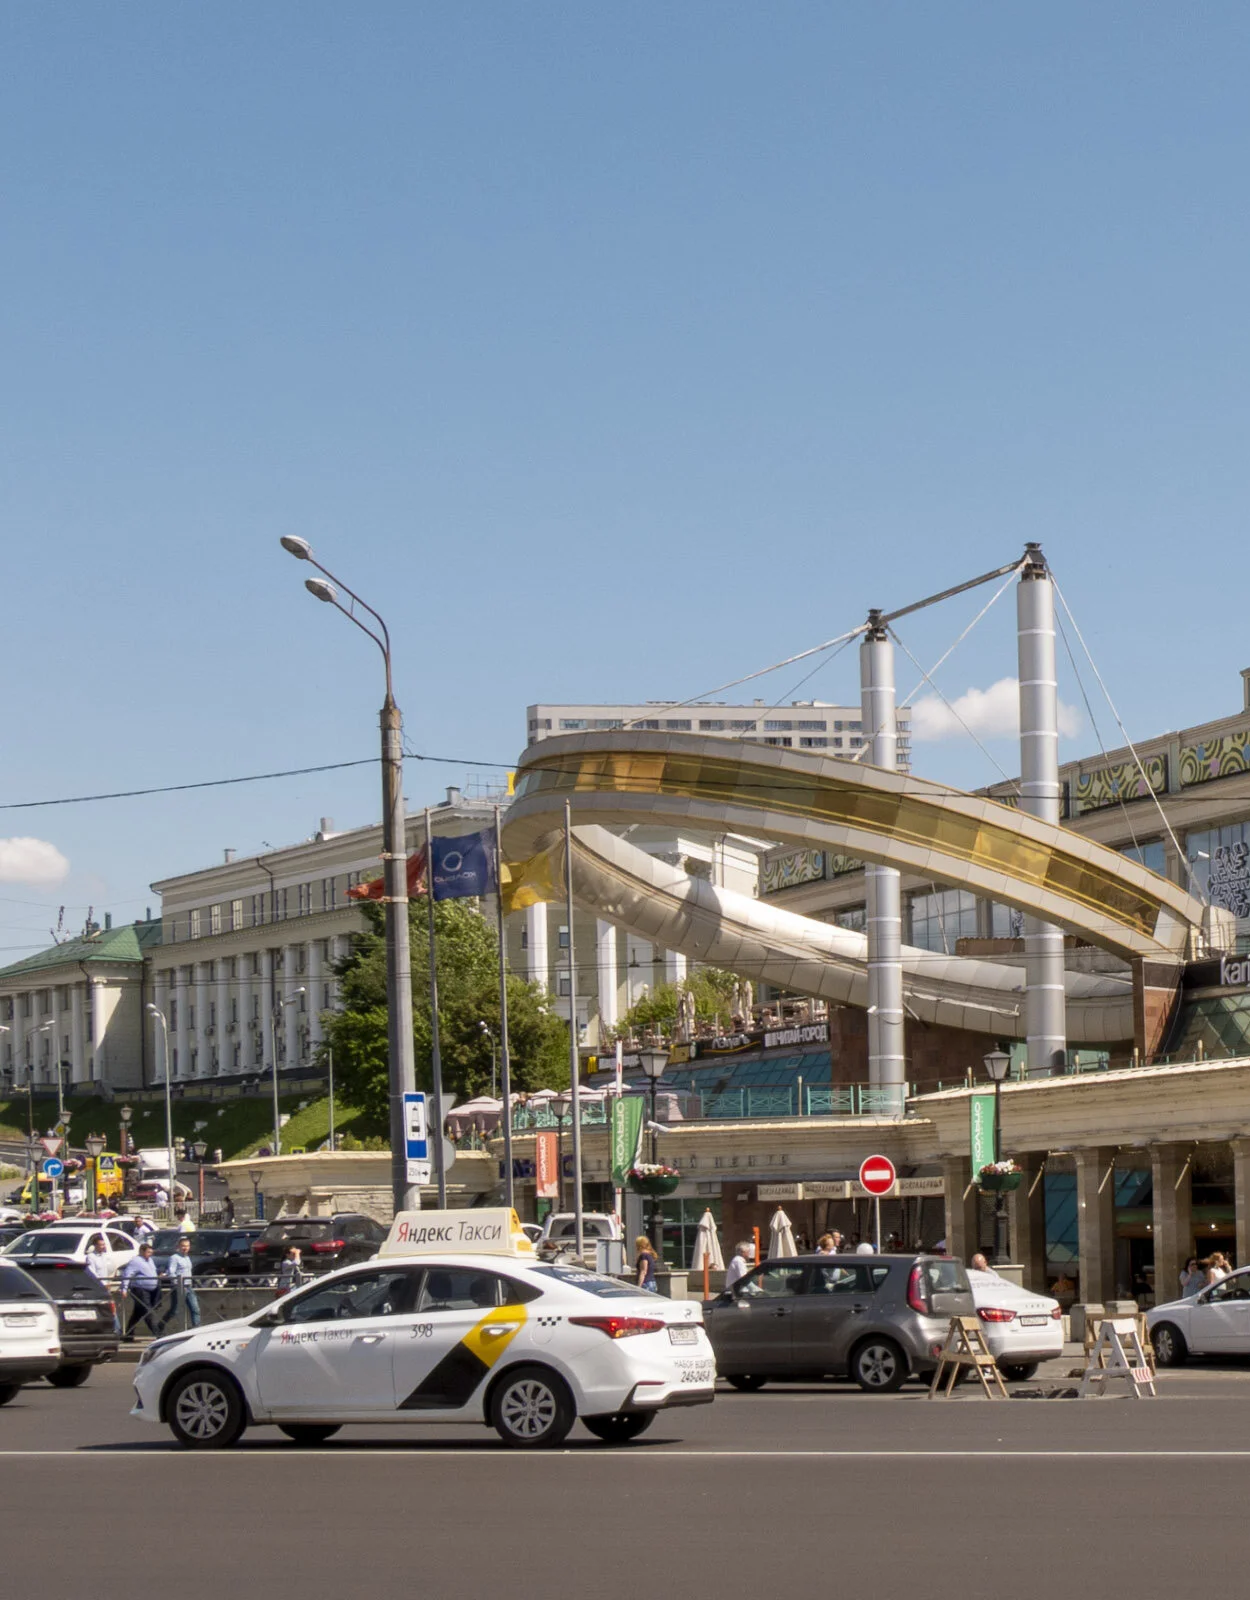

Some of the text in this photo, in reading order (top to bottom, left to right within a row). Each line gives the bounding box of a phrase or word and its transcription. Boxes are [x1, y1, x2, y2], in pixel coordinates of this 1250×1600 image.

[397, 1221, 502, 1245] Яндекс Такси
[281, 1327, 352, 1344] Яндекс Такси
[410, 1323, 433, 1339] 398
